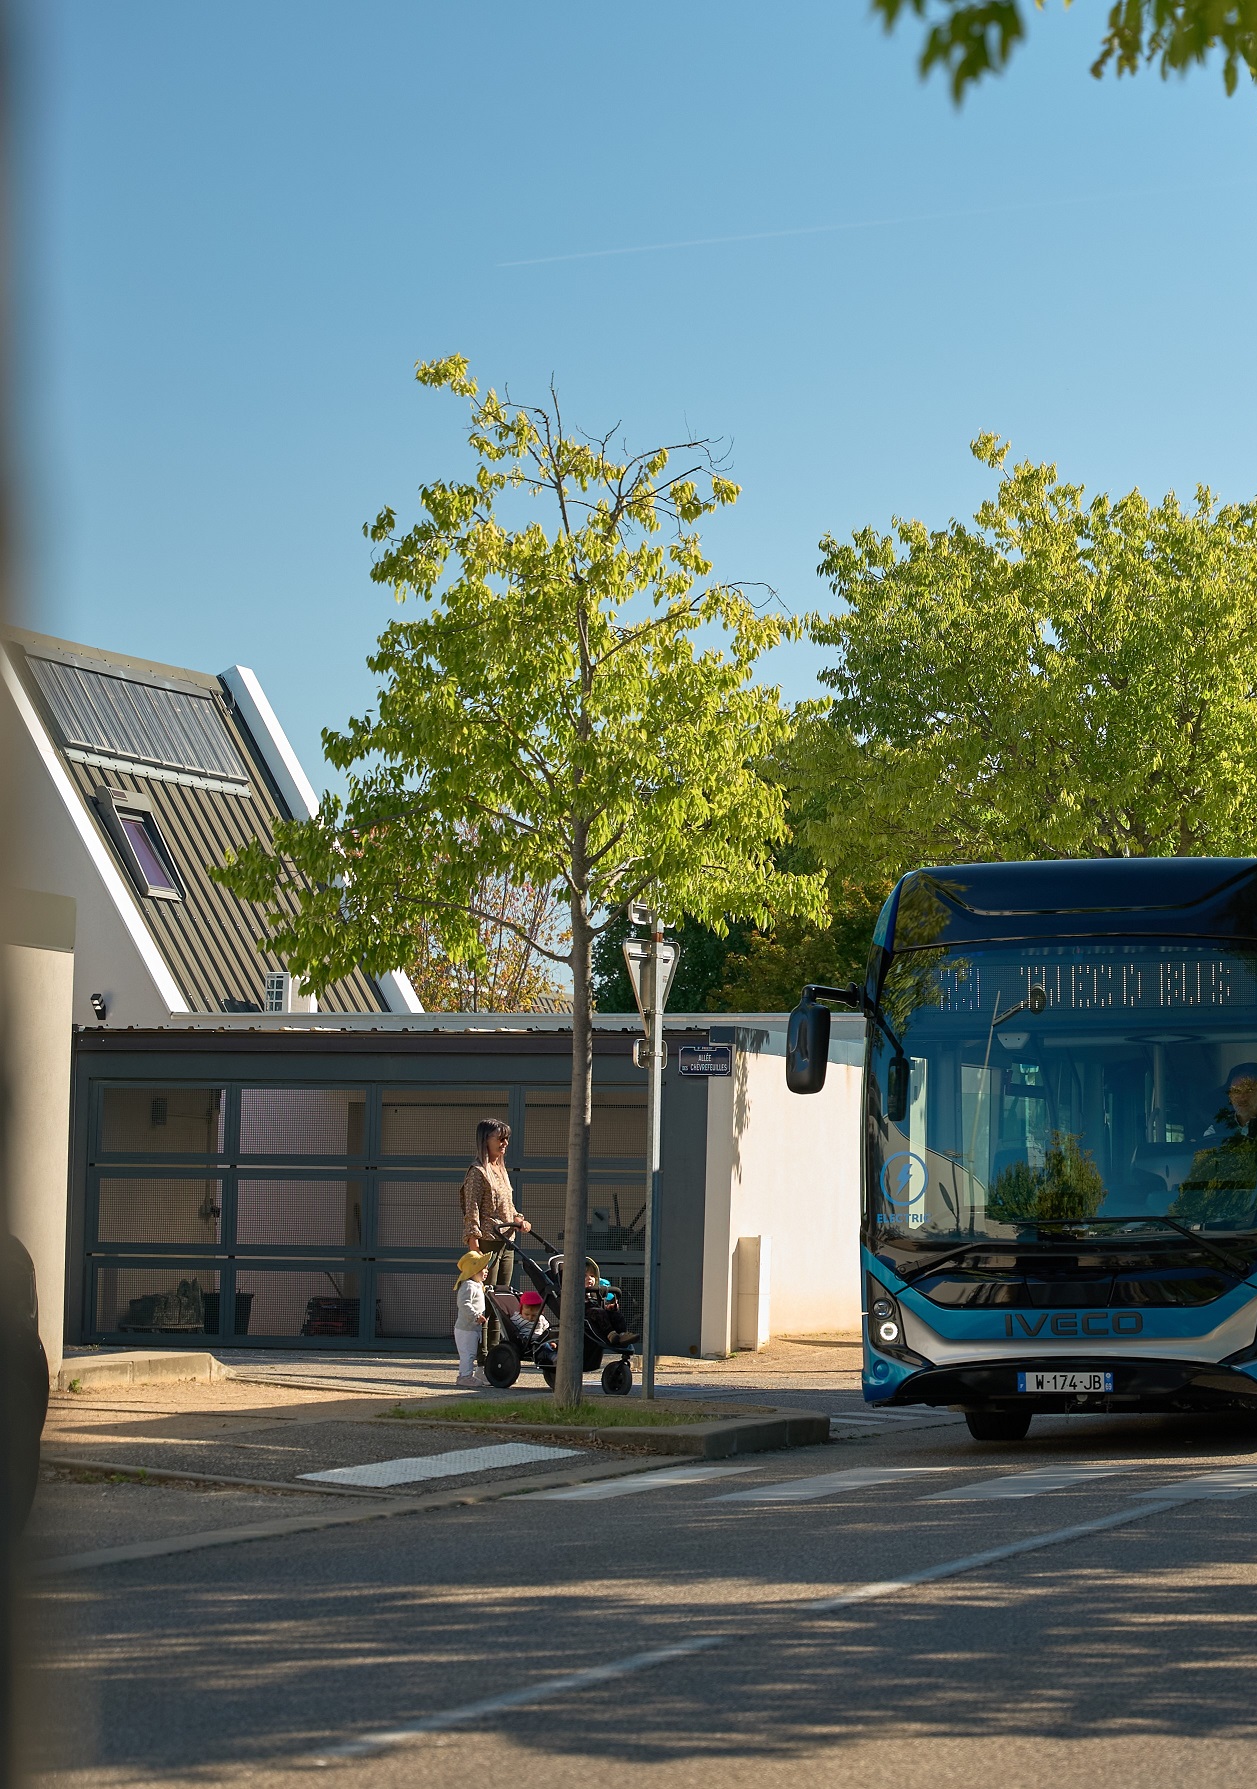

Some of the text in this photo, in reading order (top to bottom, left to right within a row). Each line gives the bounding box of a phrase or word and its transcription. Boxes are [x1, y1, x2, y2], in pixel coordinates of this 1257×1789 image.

[1160, 962, 1231, 1006] BUS
[698, 1053, 711, 1061] ALLÉE
[876, 1213, 932, 1224] ELECTRIC
[1005, 1312, 1143, 1337] IVECO
[1035, 1374, 1102, 1390] W-174-JB
